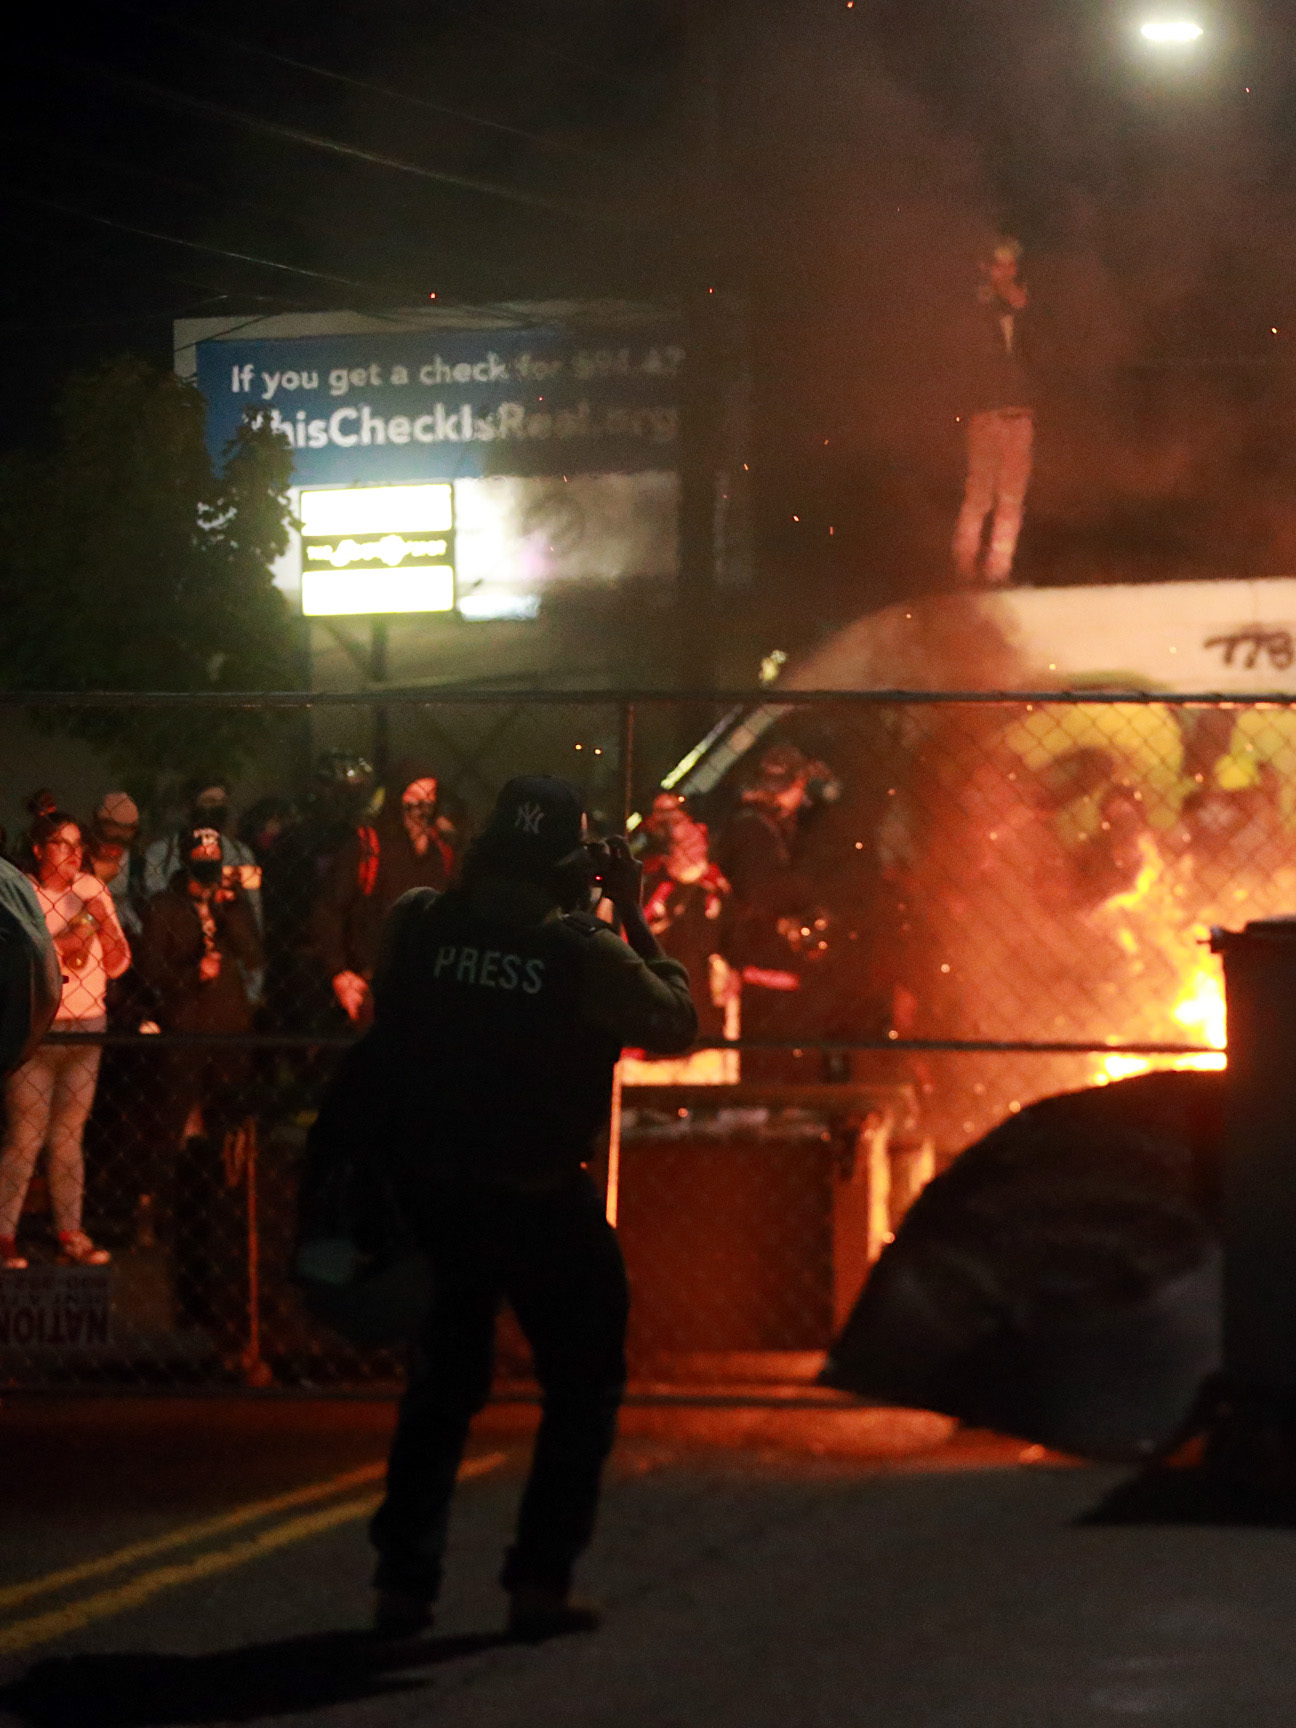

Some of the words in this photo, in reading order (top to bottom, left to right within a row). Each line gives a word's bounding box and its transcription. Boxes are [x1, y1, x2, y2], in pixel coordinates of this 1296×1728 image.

[230, 364, 255, 393] If
[262, 368, 319, 398] you
[328, 361, 381, 396] get
[389, 364, 409, 386] a
[419, 350, 508, 385] check
[433, 946, 546, 995] PRESS
